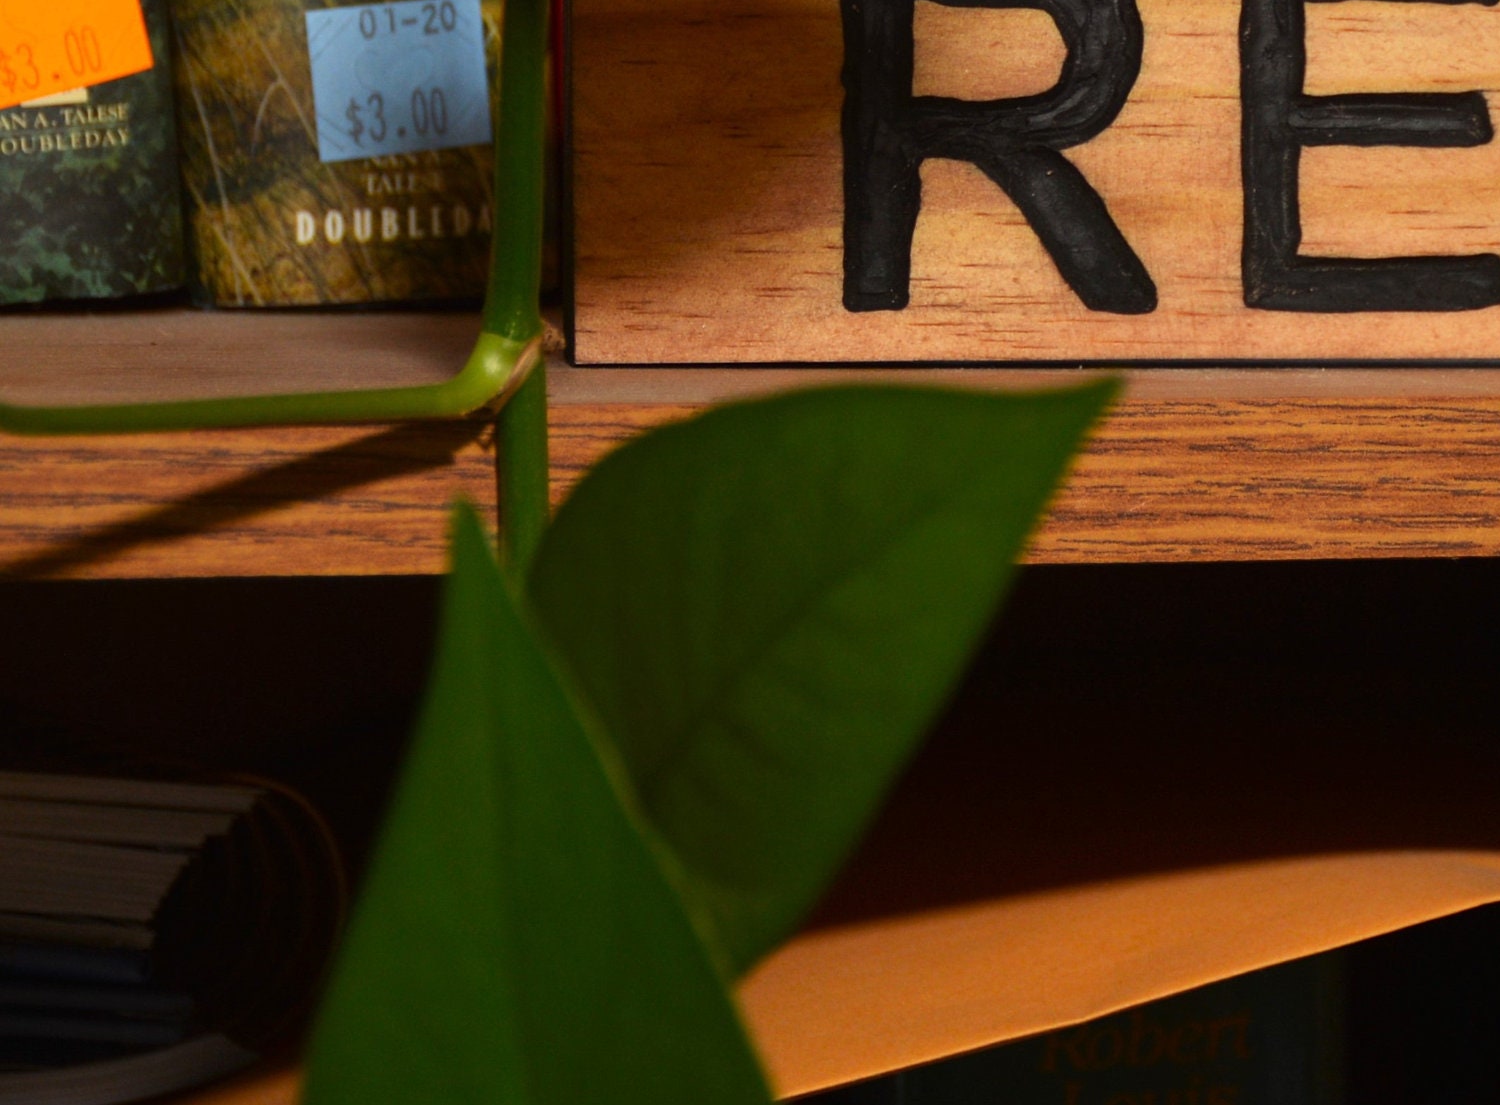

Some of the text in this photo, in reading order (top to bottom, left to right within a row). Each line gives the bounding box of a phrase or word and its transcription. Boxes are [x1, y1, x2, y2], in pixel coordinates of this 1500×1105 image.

[358, 1, 457, 40] 01-20
[60, 103, 129, 126] TALESE
[345, 86, 448, 145] $3.00
